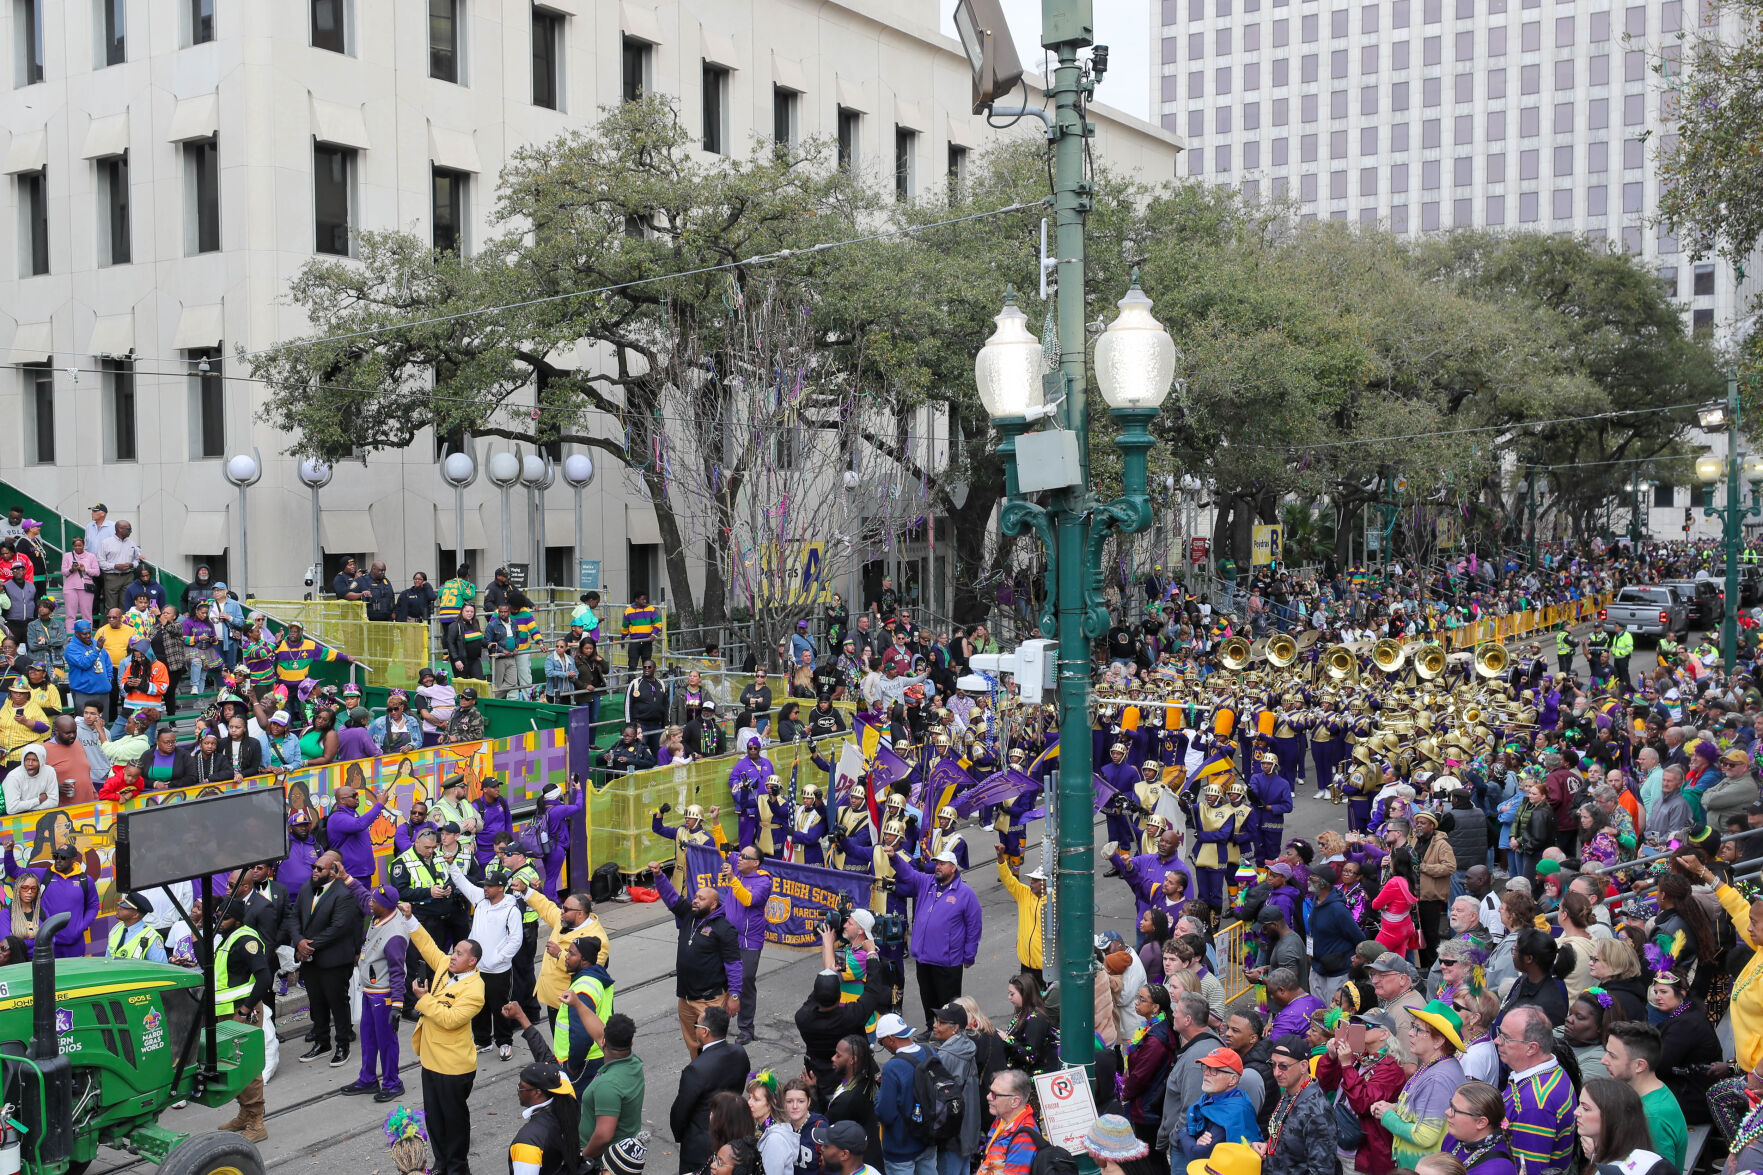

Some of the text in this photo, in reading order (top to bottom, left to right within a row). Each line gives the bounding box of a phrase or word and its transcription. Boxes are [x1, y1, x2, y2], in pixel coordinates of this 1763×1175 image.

[440, 589, 458, 607] 96
[697, 873, 716, 889] ST.
[782, 878, 809, 900] HIGH
[782, 933, 817, 944] LOUISIANA
[142, 1029, 164, 1041] MARDI
[140, 1041, 165, 1054] WORLD
[143, 1036, 162, 1047] GRAS
